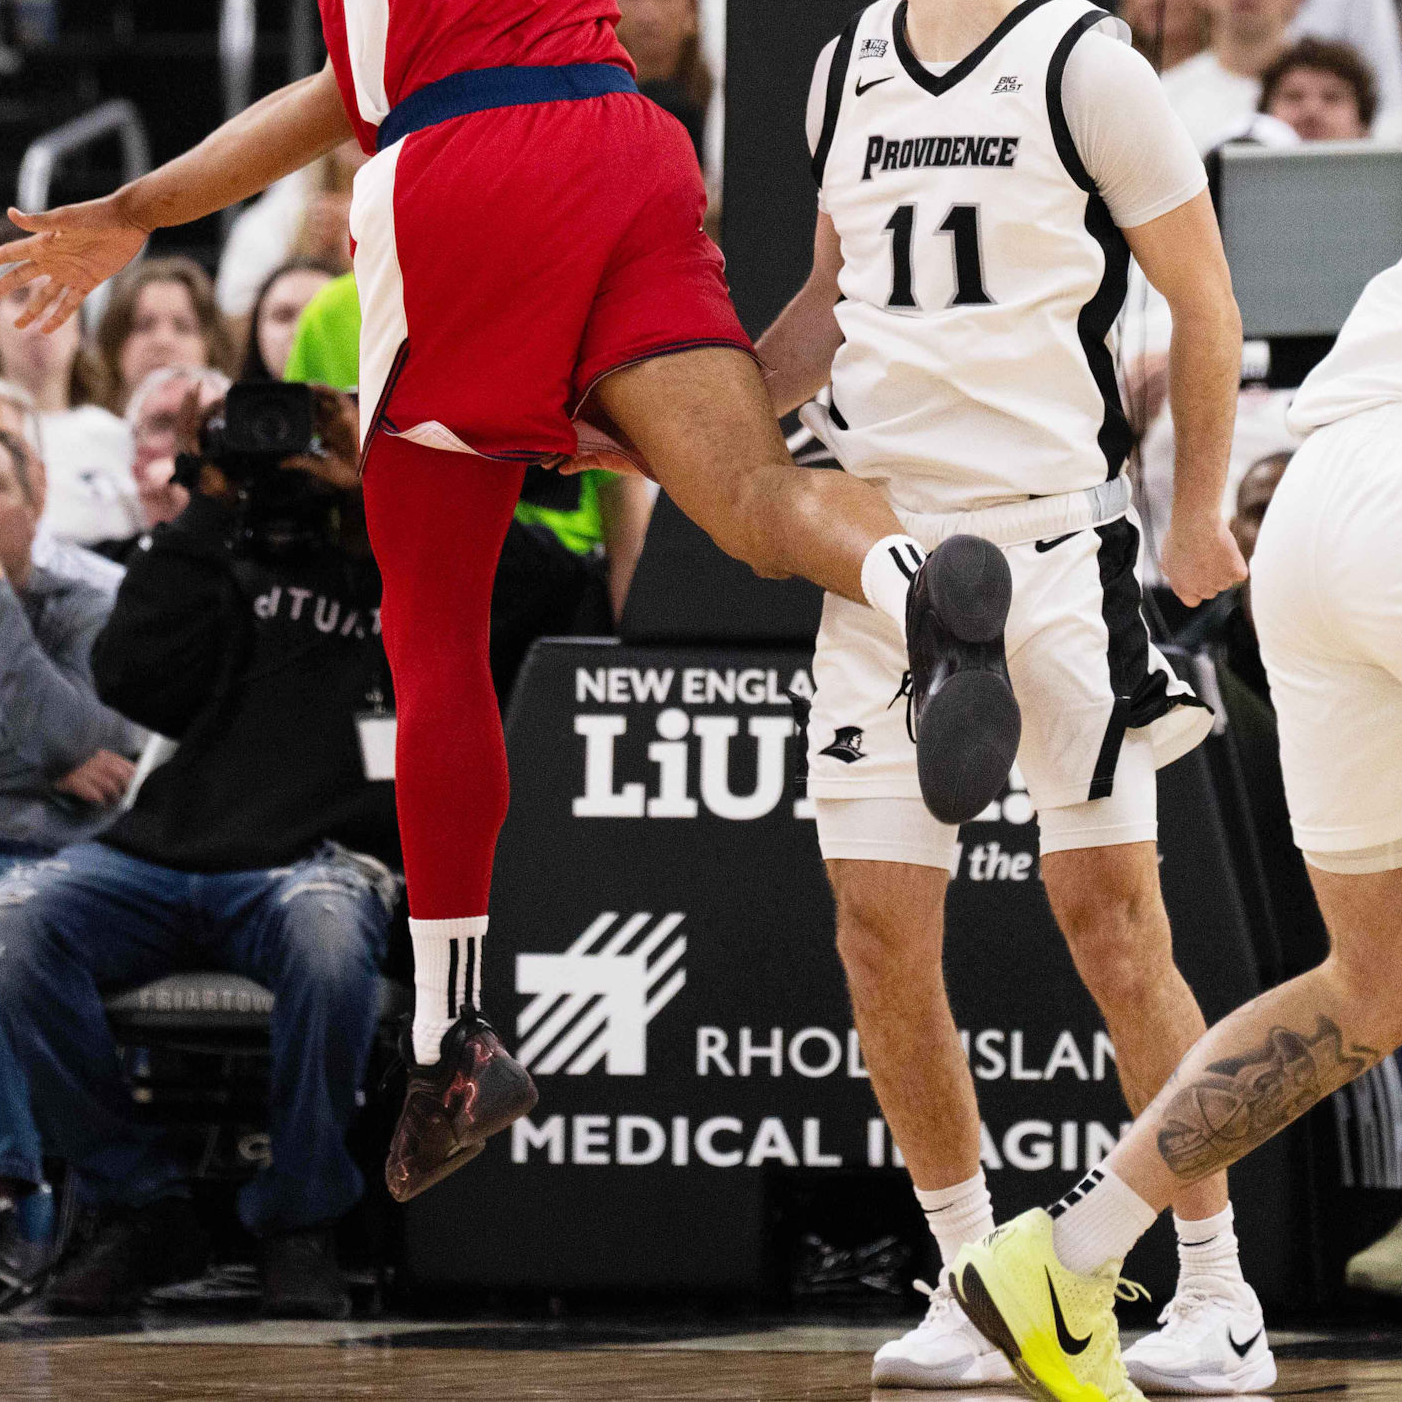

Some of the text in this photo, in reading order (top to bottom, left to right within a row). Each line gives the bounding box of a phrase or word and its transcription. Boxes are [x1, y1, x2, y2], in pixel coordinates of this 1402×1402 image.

[993, 83, 1024, 92] EAST
[999, 76, 1018, 84] BIG
[861, 136, 1020, 182] PROVIDENCE
[881, 202, 998, 311] 11
[575, 668, 675, 703] NEW
[968, 843, 1032, 881] the
[510, 1114, 844, 1168] MEDICAL
